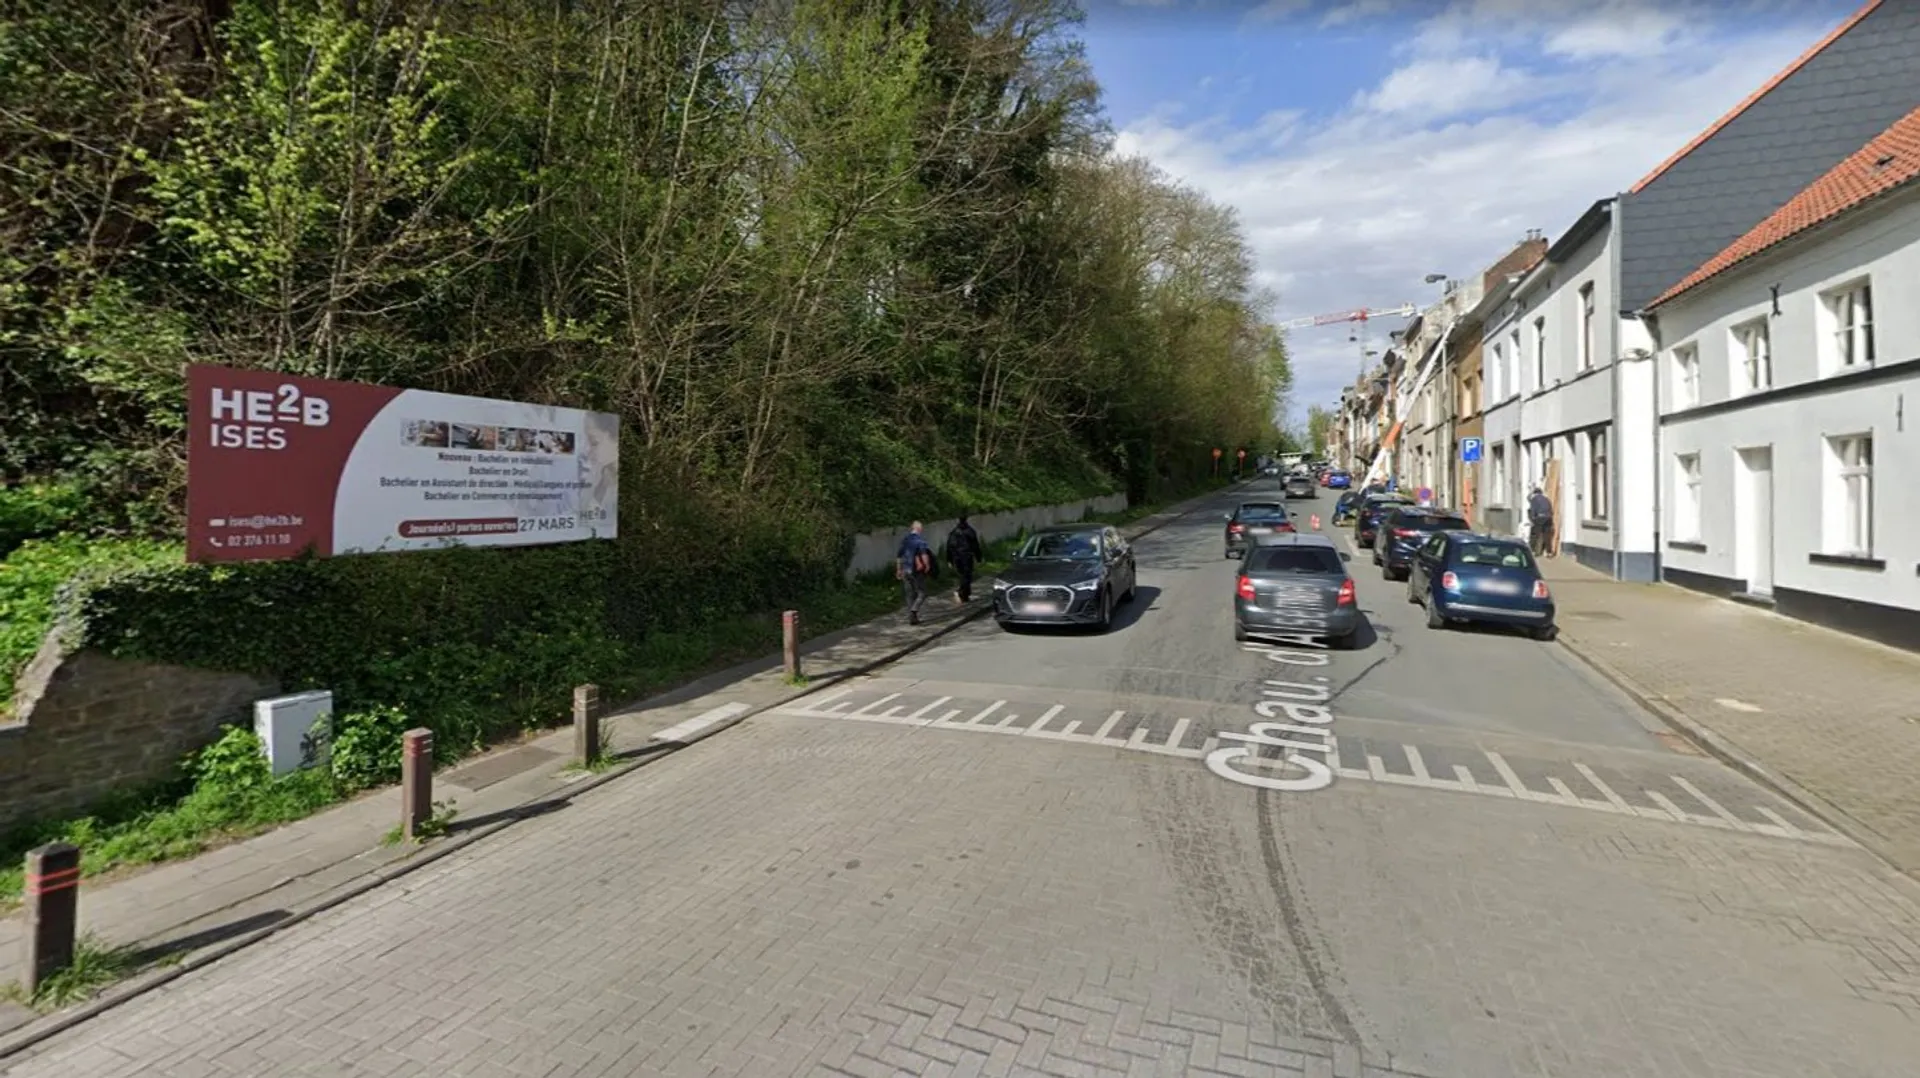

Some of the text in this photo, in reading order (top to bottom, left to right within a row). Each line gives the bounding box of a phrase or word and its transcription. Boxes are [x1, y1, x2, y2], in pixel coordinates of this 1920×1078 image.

[211, 384, 329, 426] HE2B
[211, 424, 286, 449] ISES
[1465, 440, 1478, 453] P
[469, 466, 501, 475] Bachelier
[380, 477, 419, 487] Bachelier
[424, 491, 460, 500] Bachelier
[520, 517, 574, 531] 27 MARS
